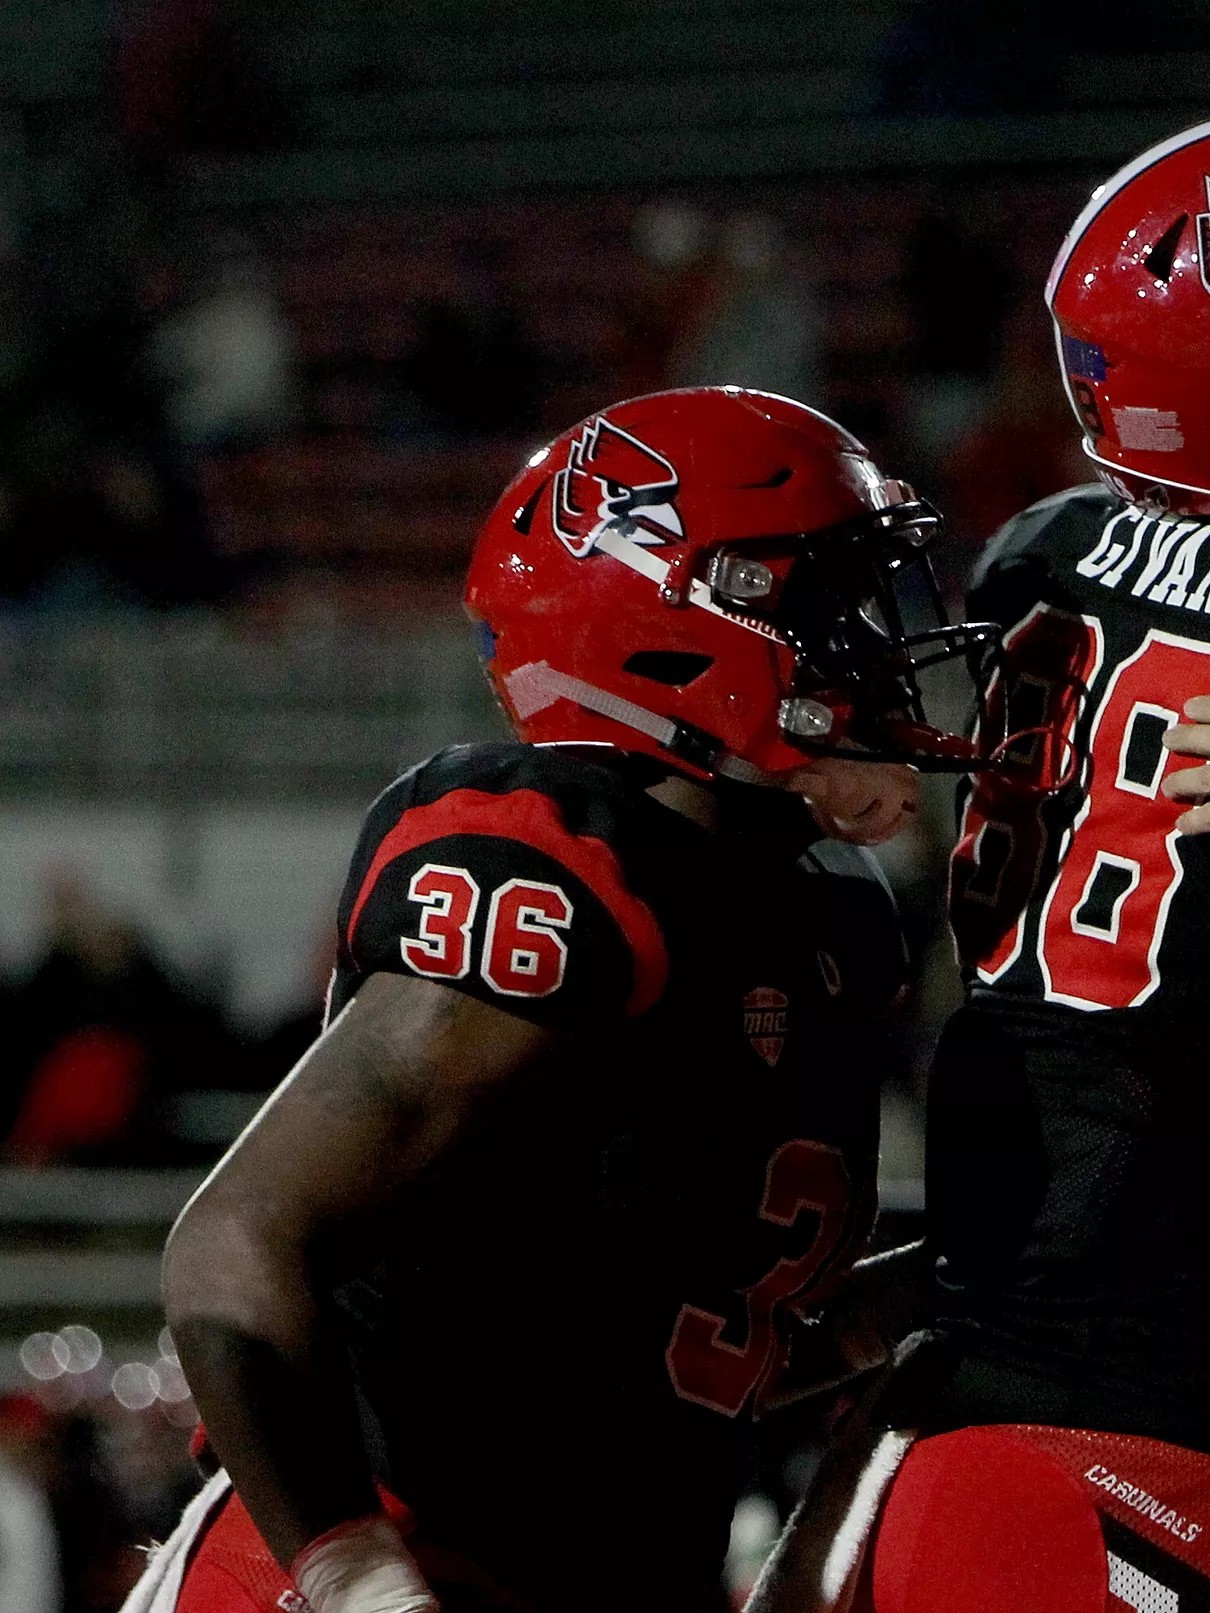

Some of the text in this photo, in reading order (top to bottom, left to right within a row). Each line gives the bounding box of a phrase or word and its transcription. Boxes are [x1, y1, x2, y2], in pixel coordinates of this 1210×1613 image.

[401, 863, 574, 998] 36
[665, 1136, 860, 1422] 3
[1084, 1464, 1203, 1543] CARDINALS
